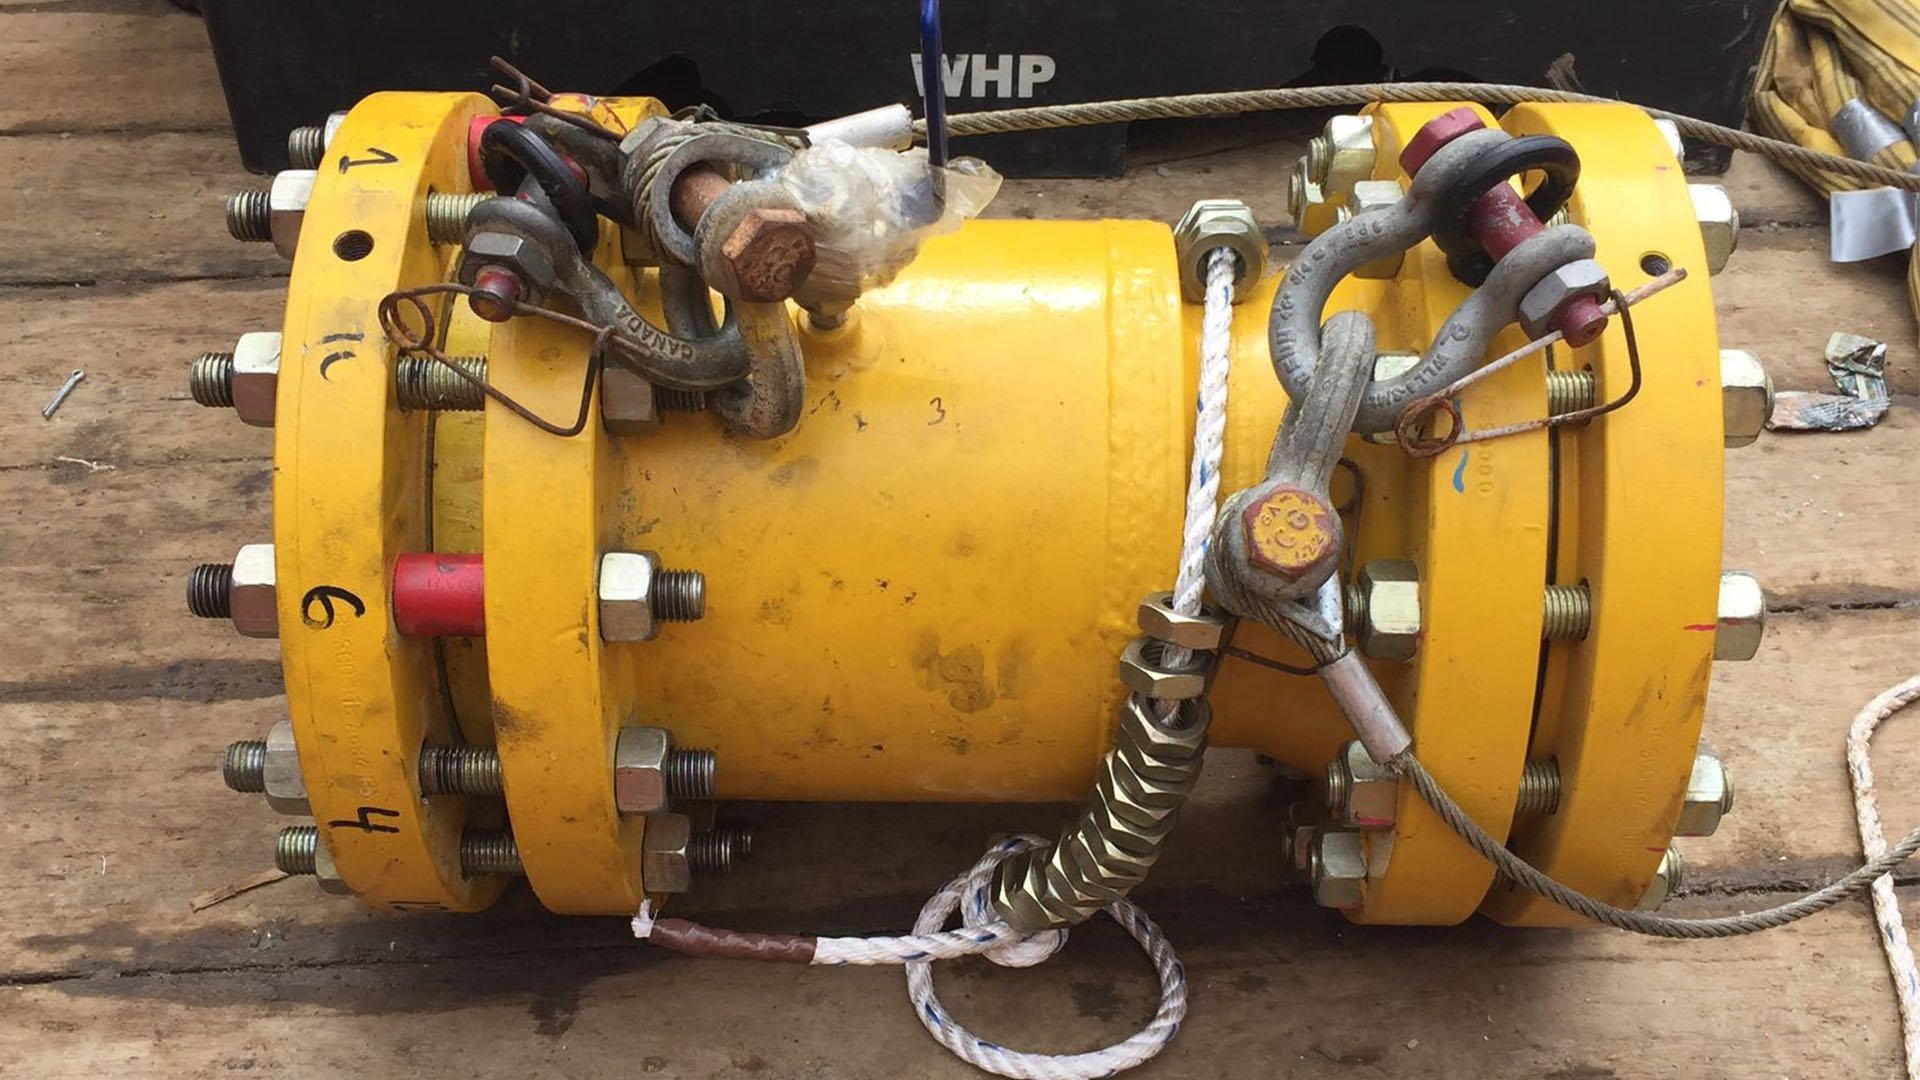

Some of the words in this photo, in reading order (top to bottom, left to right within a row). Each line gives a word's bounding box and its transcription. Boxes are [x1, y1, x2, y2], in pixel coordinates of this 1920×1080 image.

[910, 53, 1056, 98] WHP
[338, 147, 399, 175] 1
[614, 304, 694, 362] CANADA
[927, 396, 947, 426] 3
[301, 585, 366, 630] 6
[328, 806, 400, 834] 4
